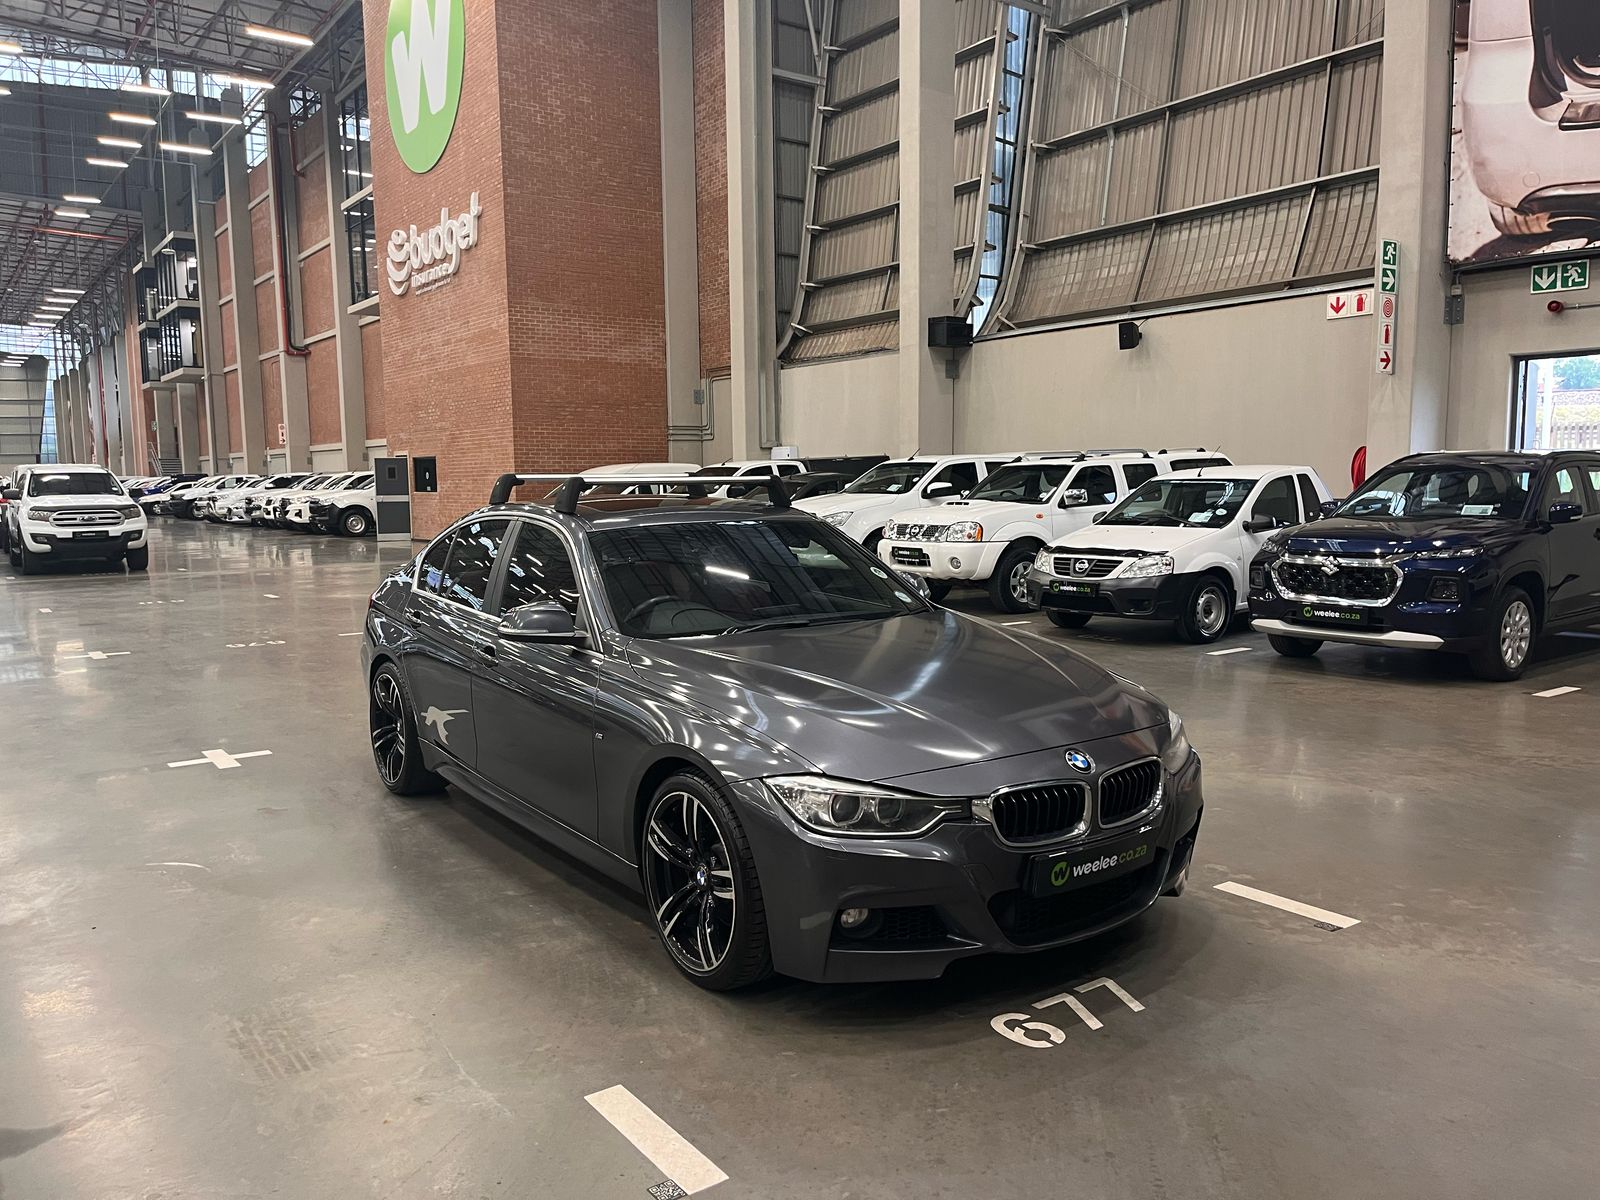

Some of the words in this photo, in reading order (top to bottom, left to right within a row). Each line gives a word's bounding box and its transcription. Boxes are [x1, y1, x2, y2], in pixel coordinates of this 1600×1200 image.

[410, 191, 482, 275] budget
[1313, 609, 1361, 620] weelee.co.za
[1073, 844, 1148, 877] weelee.co.za
[990, 977, 1146, 1049] 677
